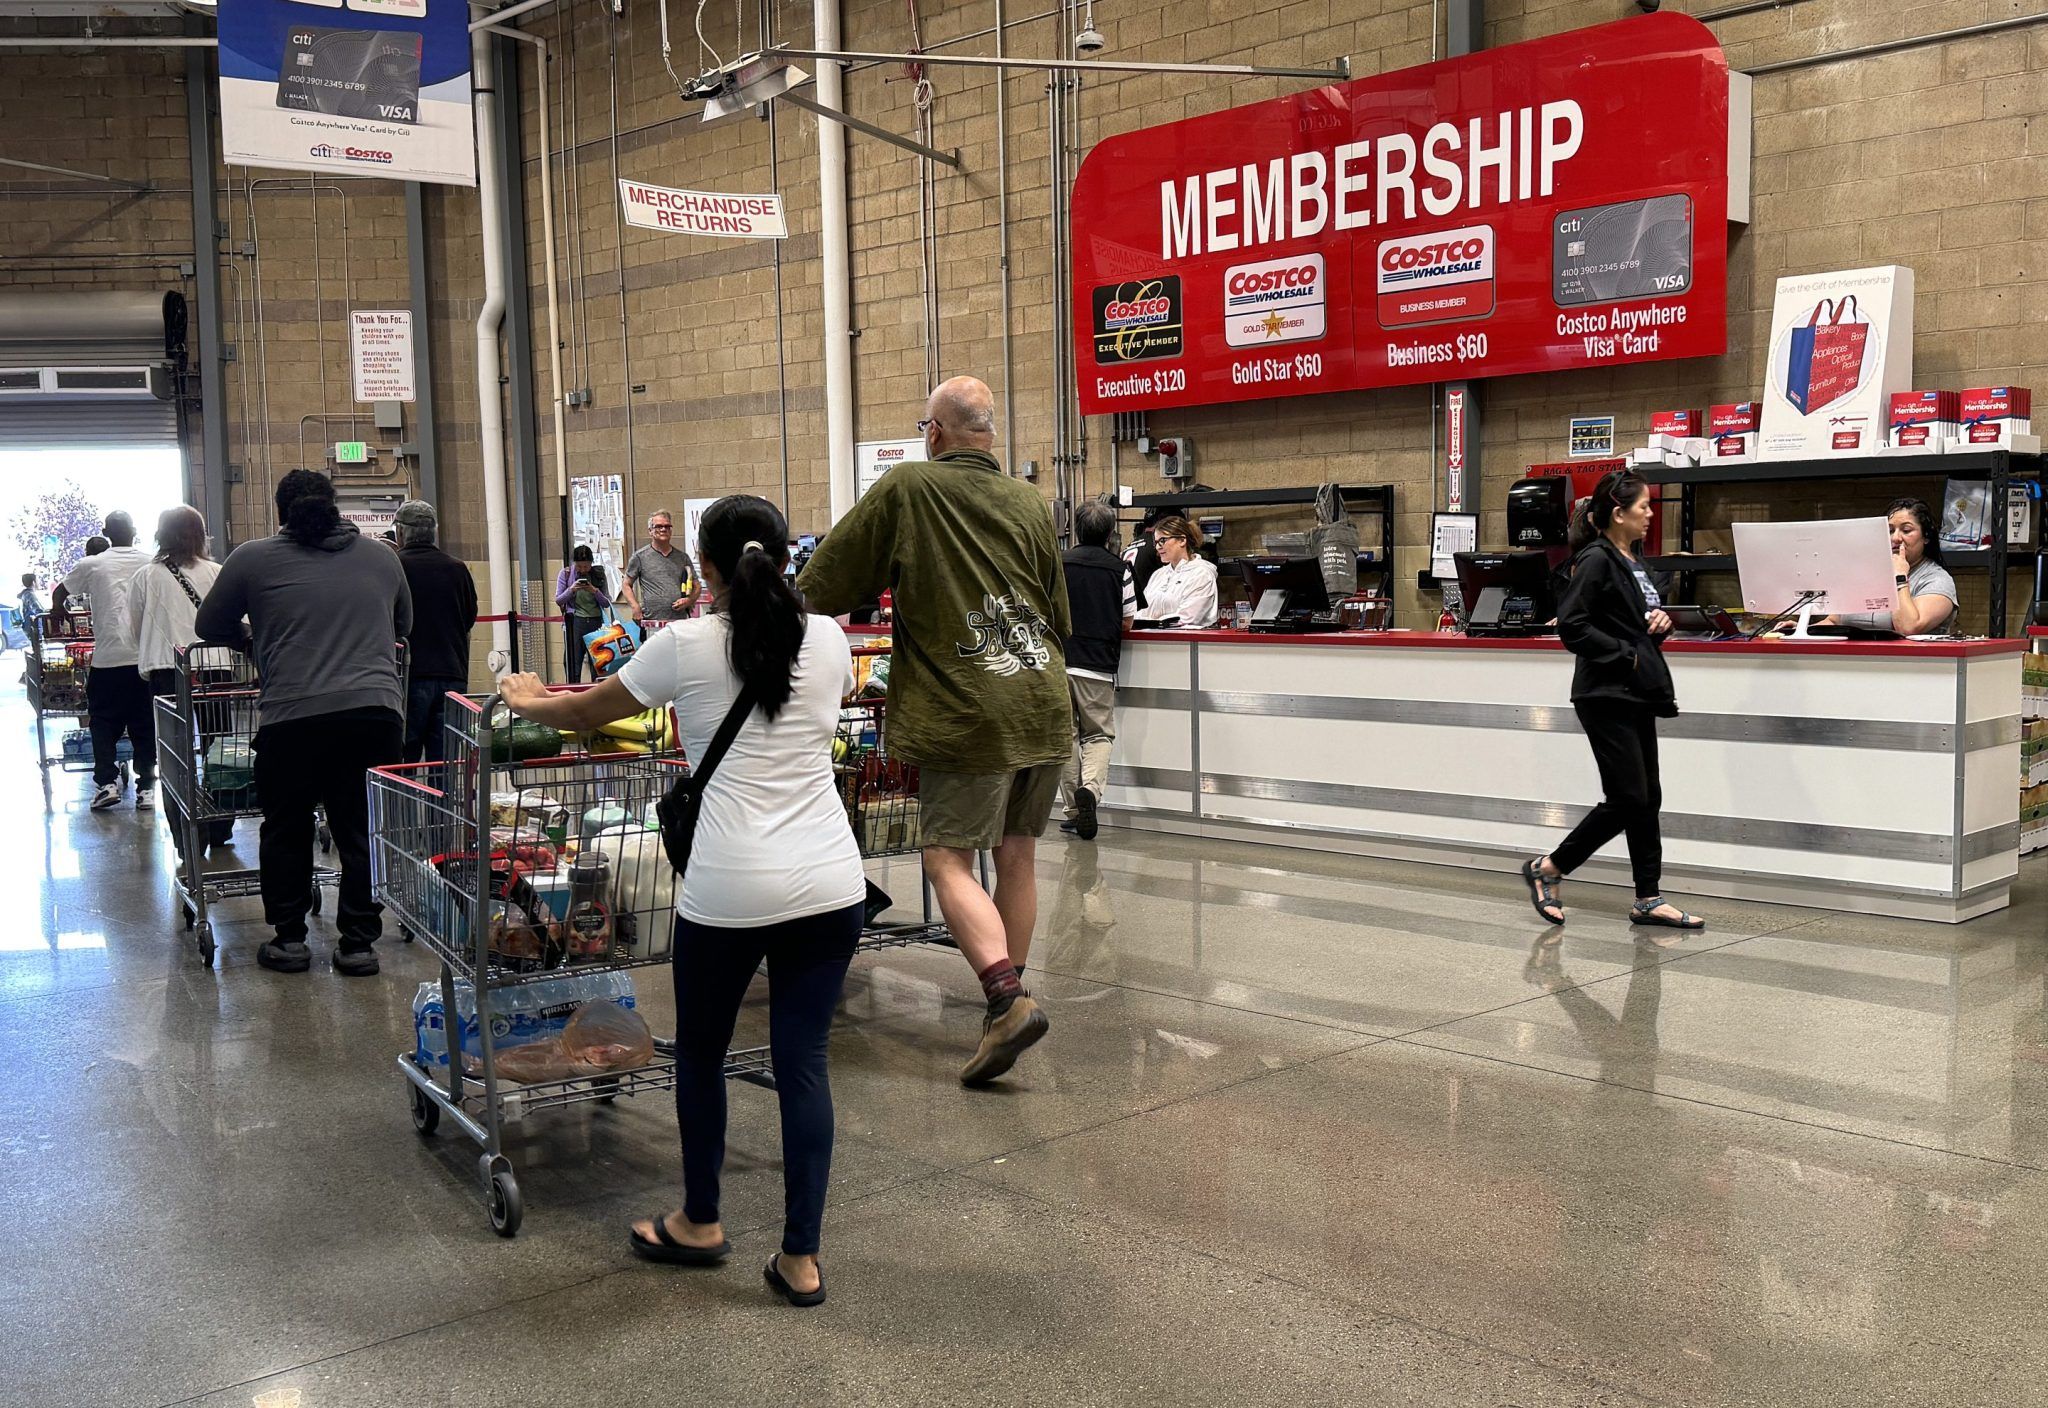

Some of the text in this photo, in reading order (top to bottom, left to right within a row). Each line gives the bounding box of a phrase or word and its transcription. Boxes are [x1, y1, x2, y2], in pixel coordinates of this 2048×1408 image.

[293, 32, 312, 46] citi
[288, 75, 366, 91] 4100 3901 2345 6789
[378, 104, 412, 120] VISA
[290, 117, 315, 126] Costco
[316, 119, 350, 130] Anywhere
[369, 126, 387, 134] Card
[388, 128, 396, 136] by
[310, 144, 332, 158] citi
[345, 147, 393, 159] COSTCO
[1161, 99, 1584, 260] MEMBERSHIP
[628, 187, 776, 215] MERCHANDISE
[656, 210, 752, 233] RETURNS
[1560, 217, 1581, 233] citi
[1381, 238, 1484, 271] COSTCO
[1412, 261, 1481, 279] WHOLESALE
[1562, 260, 1640, 277] 4100 3901 2345 6789
[1229, 265, 1317, 295] COSTCO
[1653, 275, 1685, 290] VISA
[1777, 276, 1891, 294] Give the Gift of Membership
[1255, 286, 1314, 303] WHOLESALE
[1106, 297, 1170, 319] COSTCO
[1400, 297, 1467, 313] BUSINESS MEMBER
[355, 315, 375, 324] Thank
[377, 315, 388, 324] You
[1125, 313, 1167, 325] WHOLESALE
[1243, 319, 1304, 333] GOLD STAR MEMBER
[1557, 303, 1687, 336] Costco Anywhere
[1815, 325, 1840, 336] Bakery
[1099, 336, 1178, 352] EXECUTIVE MEMBER
[1387, 333, 1487, 367] Business $60
[1622, 330, 1658, 355] Card
[1812, 345, 1849, 359] Appliances
[1831, 352, 1853, 365] Optical
[1232, 353, 1322, 384] Gold Star $60
[1097, 369, 1186, 398] Executive $120
[1808, 376, 1837, 393] Furniture
[1451, 398, 1461, 406] FIRE
[1894, 405, 1937, 415] Membership
[1964, 401, 2008, 412] Membership
[1653, 424, 1688, 433] Membership
[1713, 417, 1751, 426] Membership
[341, 445, 363, 460] EXIT
[877, 449, 904, 457] COSTCO
[1543, 467, 1561, 476] BAG
[1564, 466, 1573, 475] &
[1577, 465, 1596, 474] TAG
